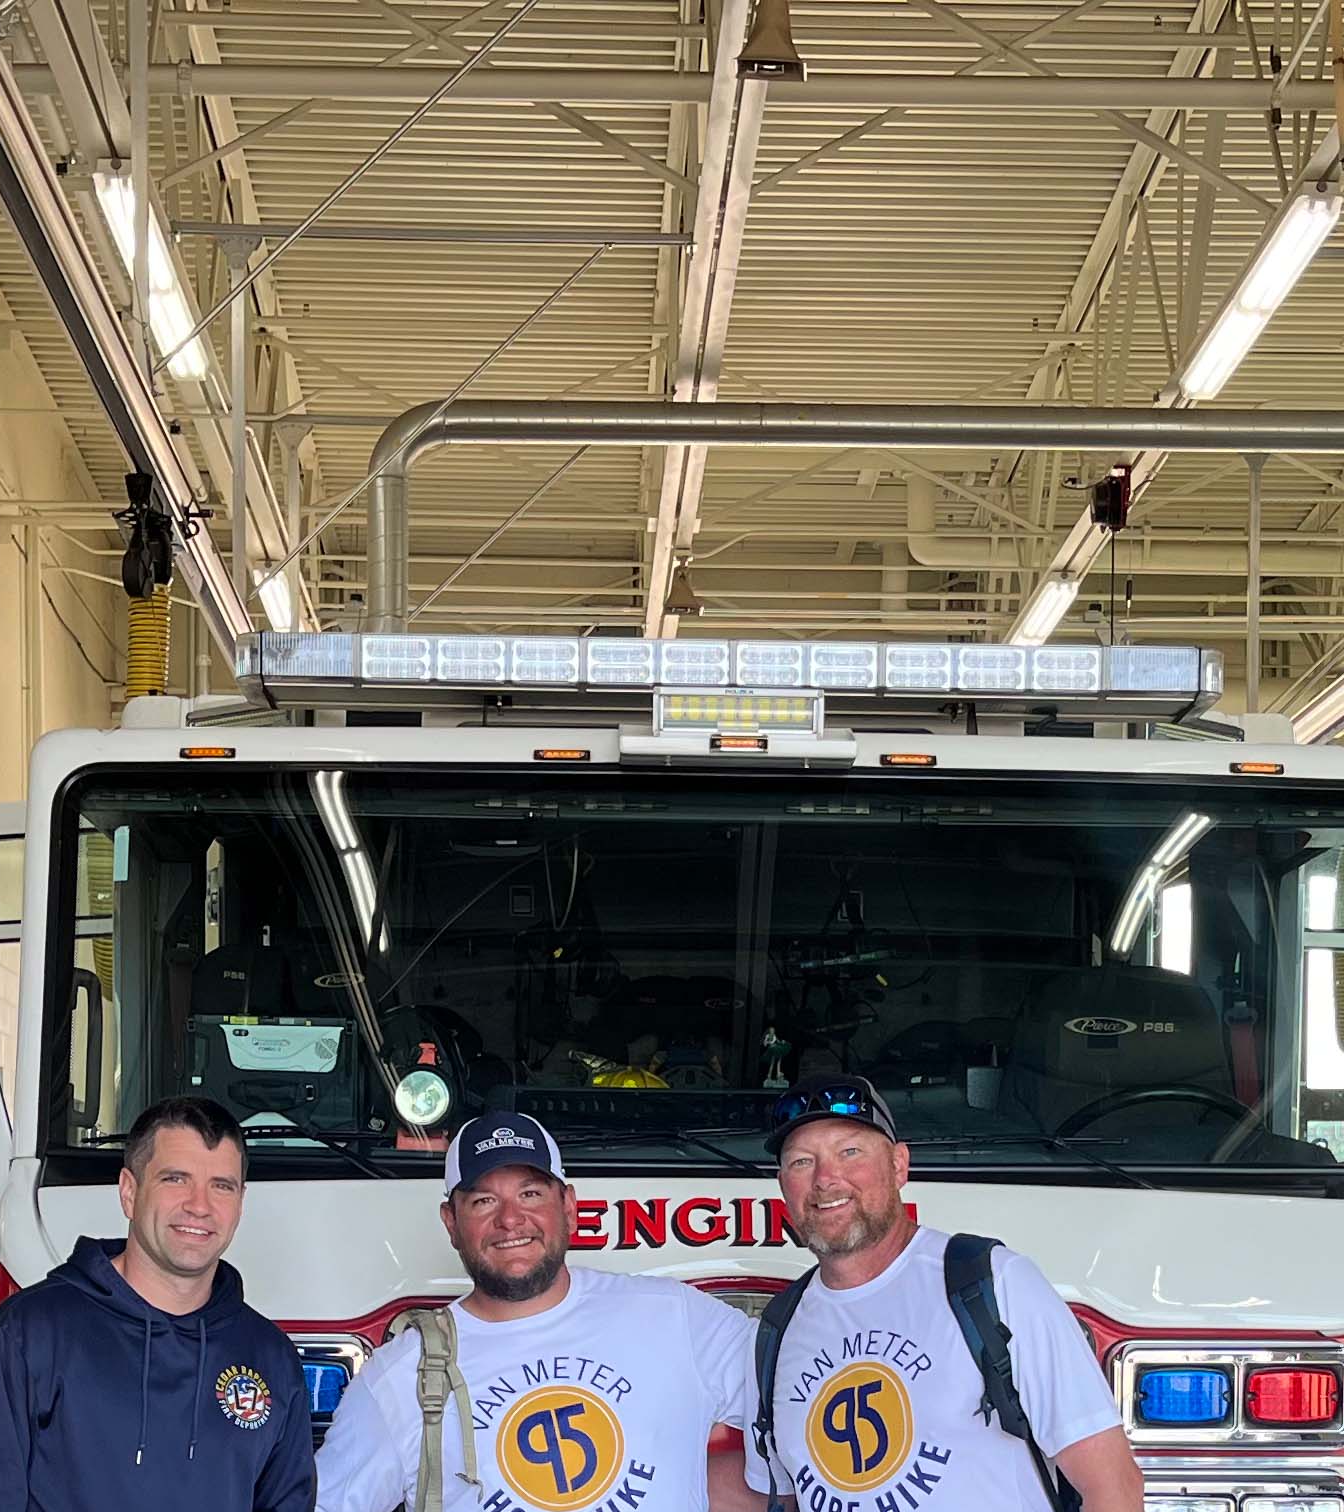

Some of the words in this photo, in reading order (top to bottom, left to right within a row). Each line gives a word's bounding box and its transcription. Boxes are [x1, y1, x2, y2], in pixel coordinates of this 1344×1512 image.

[1080, 1018, 1122, 1032] Pierce
[216, 1365, 239, 1392] CEDAR
[240, 1365, 271, 1397] RAPIDS
[472, 1377, 517, 1430] VAN
[522, 1356, 632, 1403] METER
[789, 1348, 834, 1403] VAN
[842, 1330, 932, 1381] METER
[517, 1402, 598, 1495] 95
[823, 1379, 888, 1475] 95
